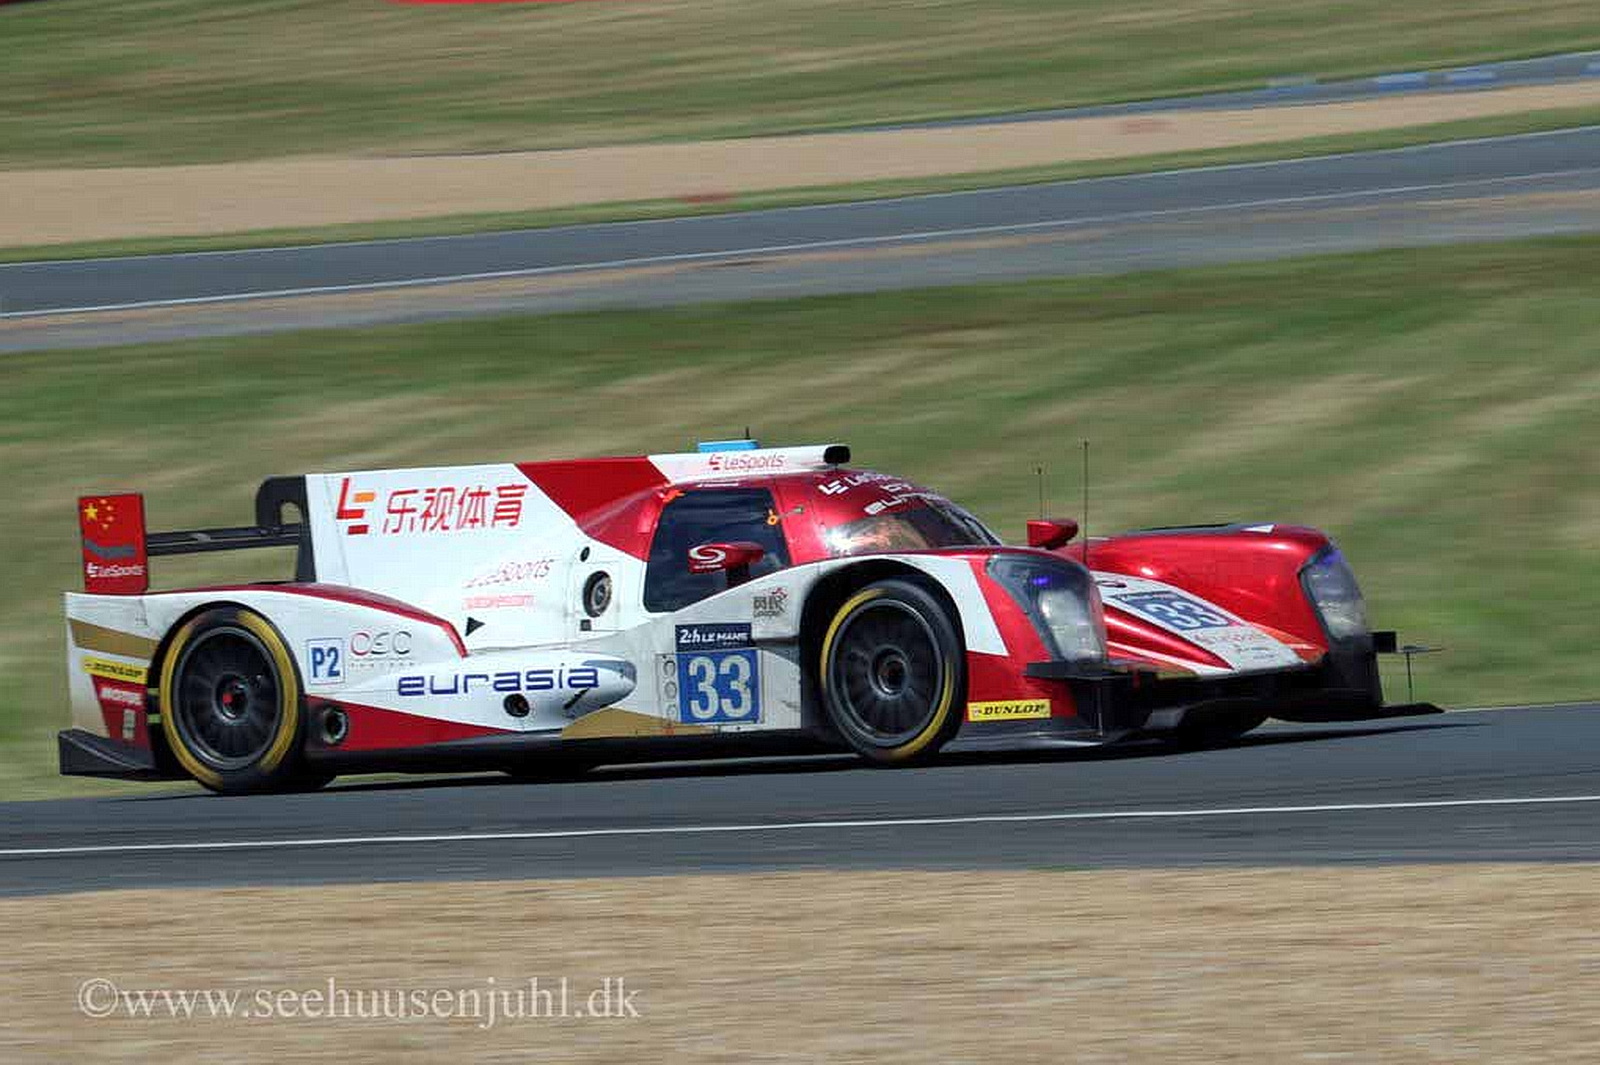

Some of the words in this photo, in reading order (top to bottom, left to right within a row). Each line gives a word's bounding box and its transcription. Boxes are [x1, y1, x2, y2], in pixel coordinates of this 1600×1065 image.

[382, 484, 528, 534] 乐视体育
[1145, 600, 1229, 628] 33
[311, 647, 340, 678] P2
[397, 663, 600, 697] eurasia
[688, 654, 751, 719] 33
[983, 704, 1046, 715] DUNLOP
